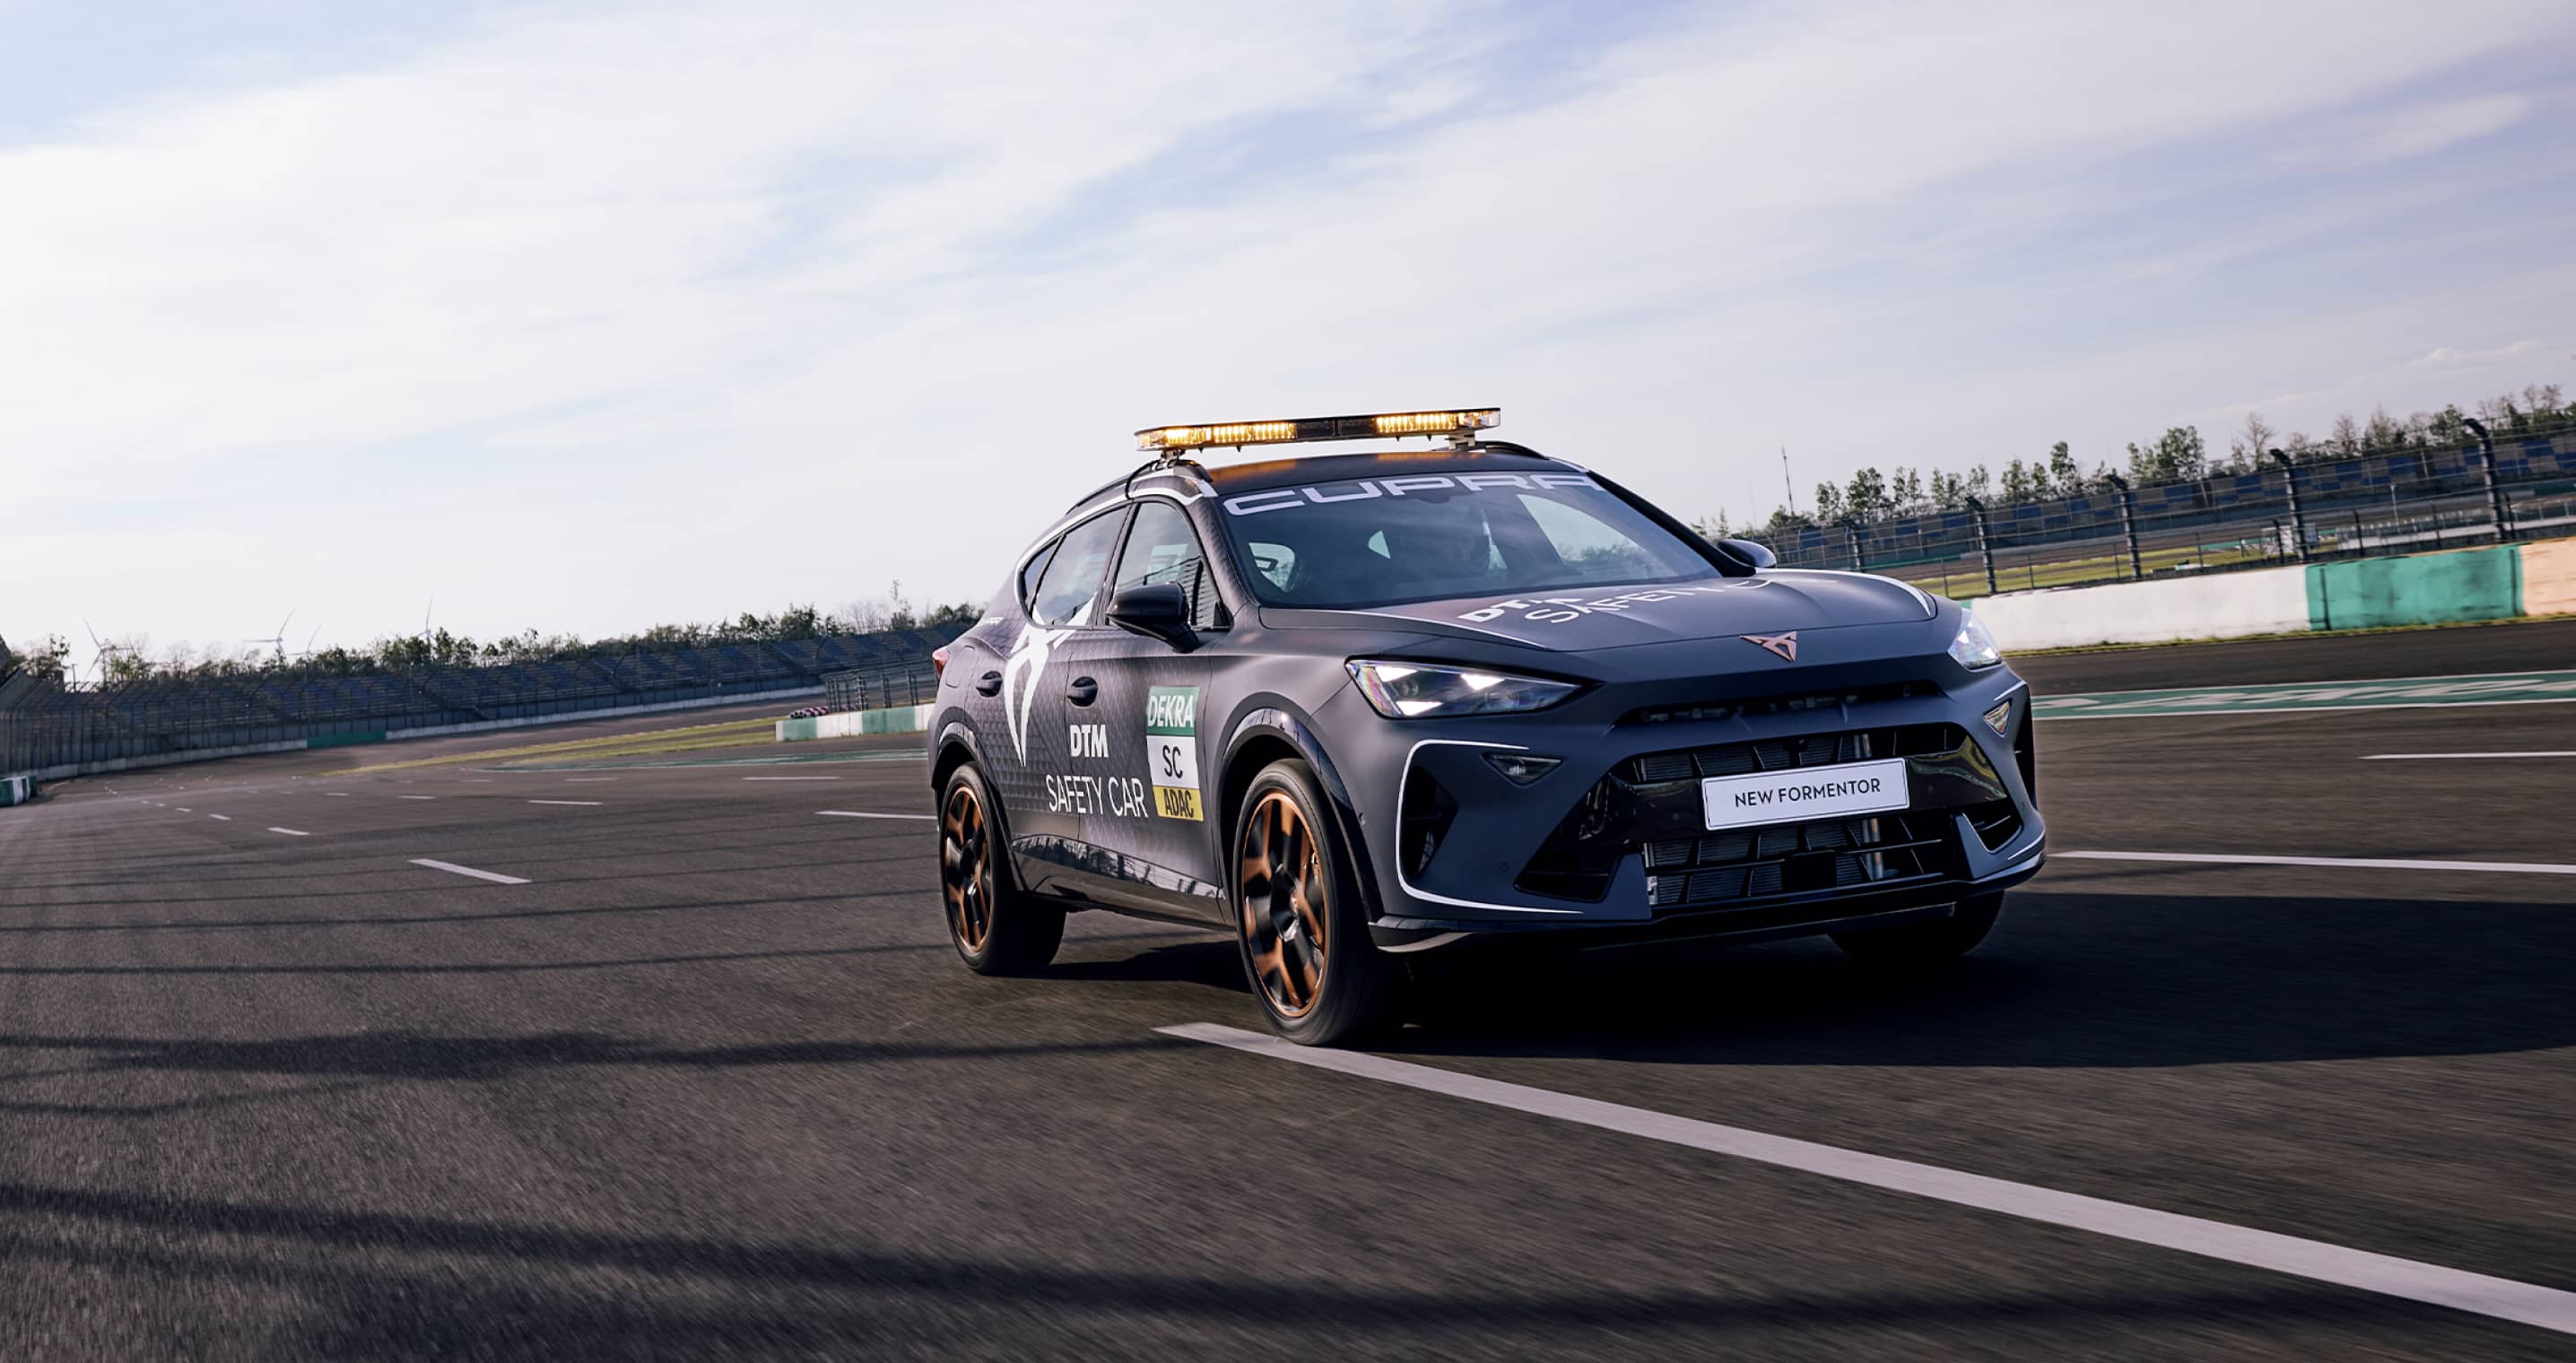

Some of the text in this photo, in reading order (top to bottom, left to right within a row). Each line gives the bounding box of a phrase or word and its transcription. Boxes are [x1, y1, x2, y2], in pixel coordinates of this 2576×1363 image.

[1223, 473, 1605, 517] CUPRA
[1147, 695, 1195, 728] DEKRA
[1069, 724, 1110, 758] DTM
[1162, 744, 1183, 779] SC
[1045, 774, 1149, 818] SAFETY CAR
[1163, 788, 1195, 819] ADAC
[1735, 777, 1881, 807] NEW FORMENTOR
